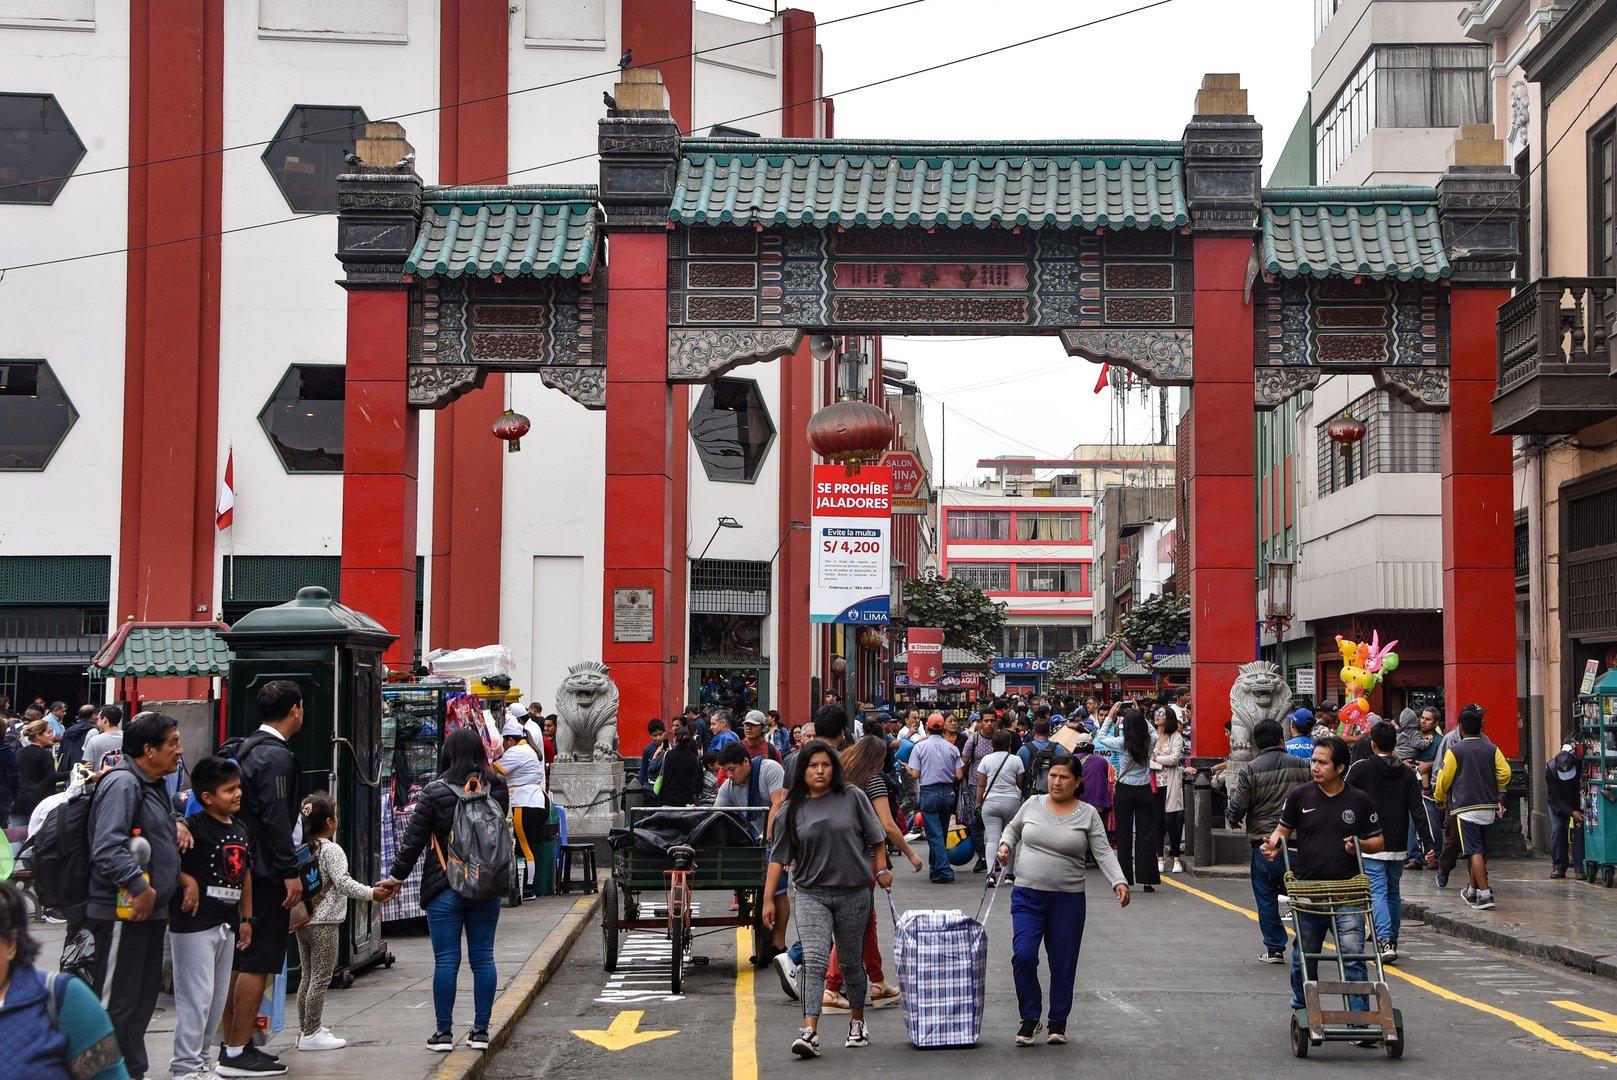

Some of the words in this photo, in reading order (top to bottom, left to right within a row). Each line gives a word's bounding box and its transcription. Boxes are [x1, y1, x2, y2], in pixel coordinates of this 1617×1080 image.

[886, 459, 913, 467] SALON
[892, 470, 918, 480] HINA
[817, 482, 832, 494] SE
[834, 481, 889, 495] PROHÍBE
[815, 496, 889, 510] JALADORES
[827, 528, 846, 536] Evite
[847, 528, 854, 536] la
[855, 529, 877, 537] multa
[823, 540, 838, 554] S/
[840, 541, 880, 555] 4,200
[863, 613, 888, 621] LIMA
[1031, 660, 1054, 671] BCP
[1286, 742, 1314, 751] FISCALIZA
